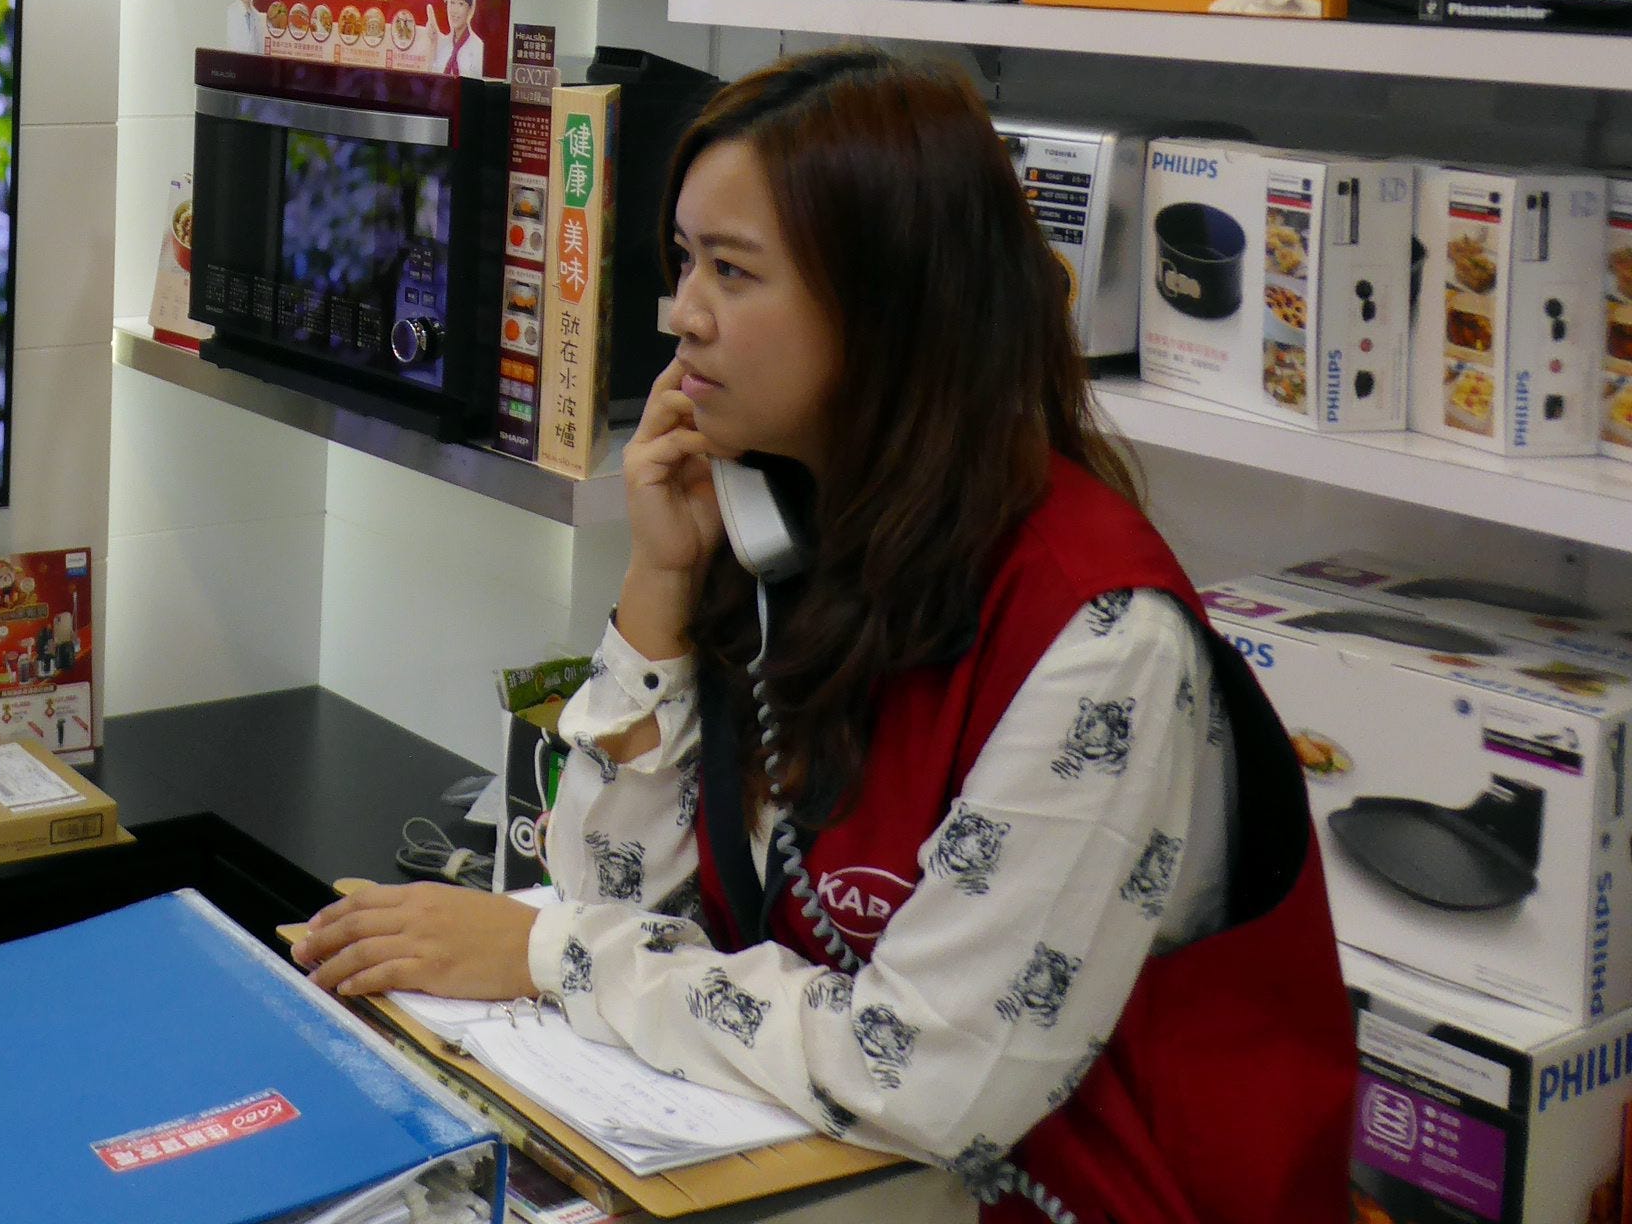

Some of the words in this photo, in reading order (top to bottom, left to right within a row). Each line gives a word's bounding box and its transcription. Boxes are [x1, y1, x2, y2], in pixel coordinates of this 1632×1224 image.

[565, 123, 591, 197] 健康
[1152, 152, 1218, 179] PHILIPS
[560, 218, 585, 291] 美味
[1327, 349, 1343, 423] PHILIPS
[1515, 372, 1531, 447] PHILIPS
[817, 871, 892, 918] KAB
[1538, 1031, 1632, 1113] PHILI
